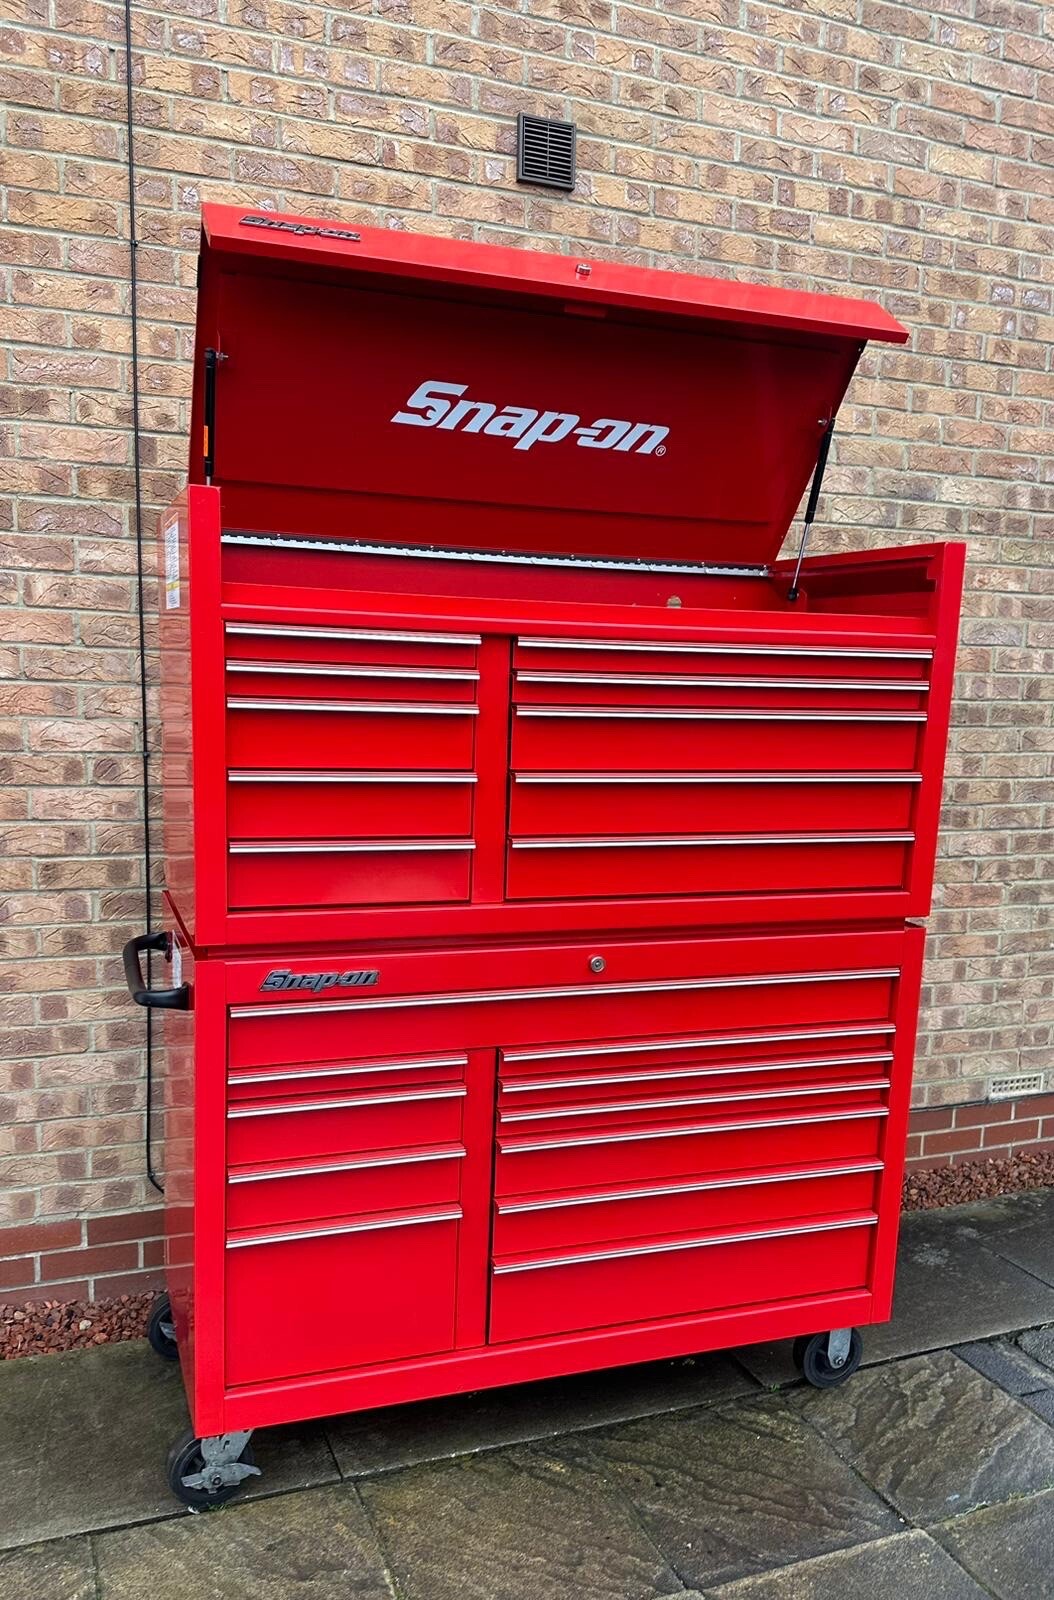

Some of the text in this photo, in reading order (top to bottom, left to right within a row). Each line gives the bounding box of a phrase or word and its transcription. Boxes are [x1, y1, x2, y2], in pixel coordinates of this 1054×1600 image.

[239, 215, 361, 241] Snap-on
[390, 380, 670, 454] Snap-on
[260, 968, 379, 992] Snap-on
